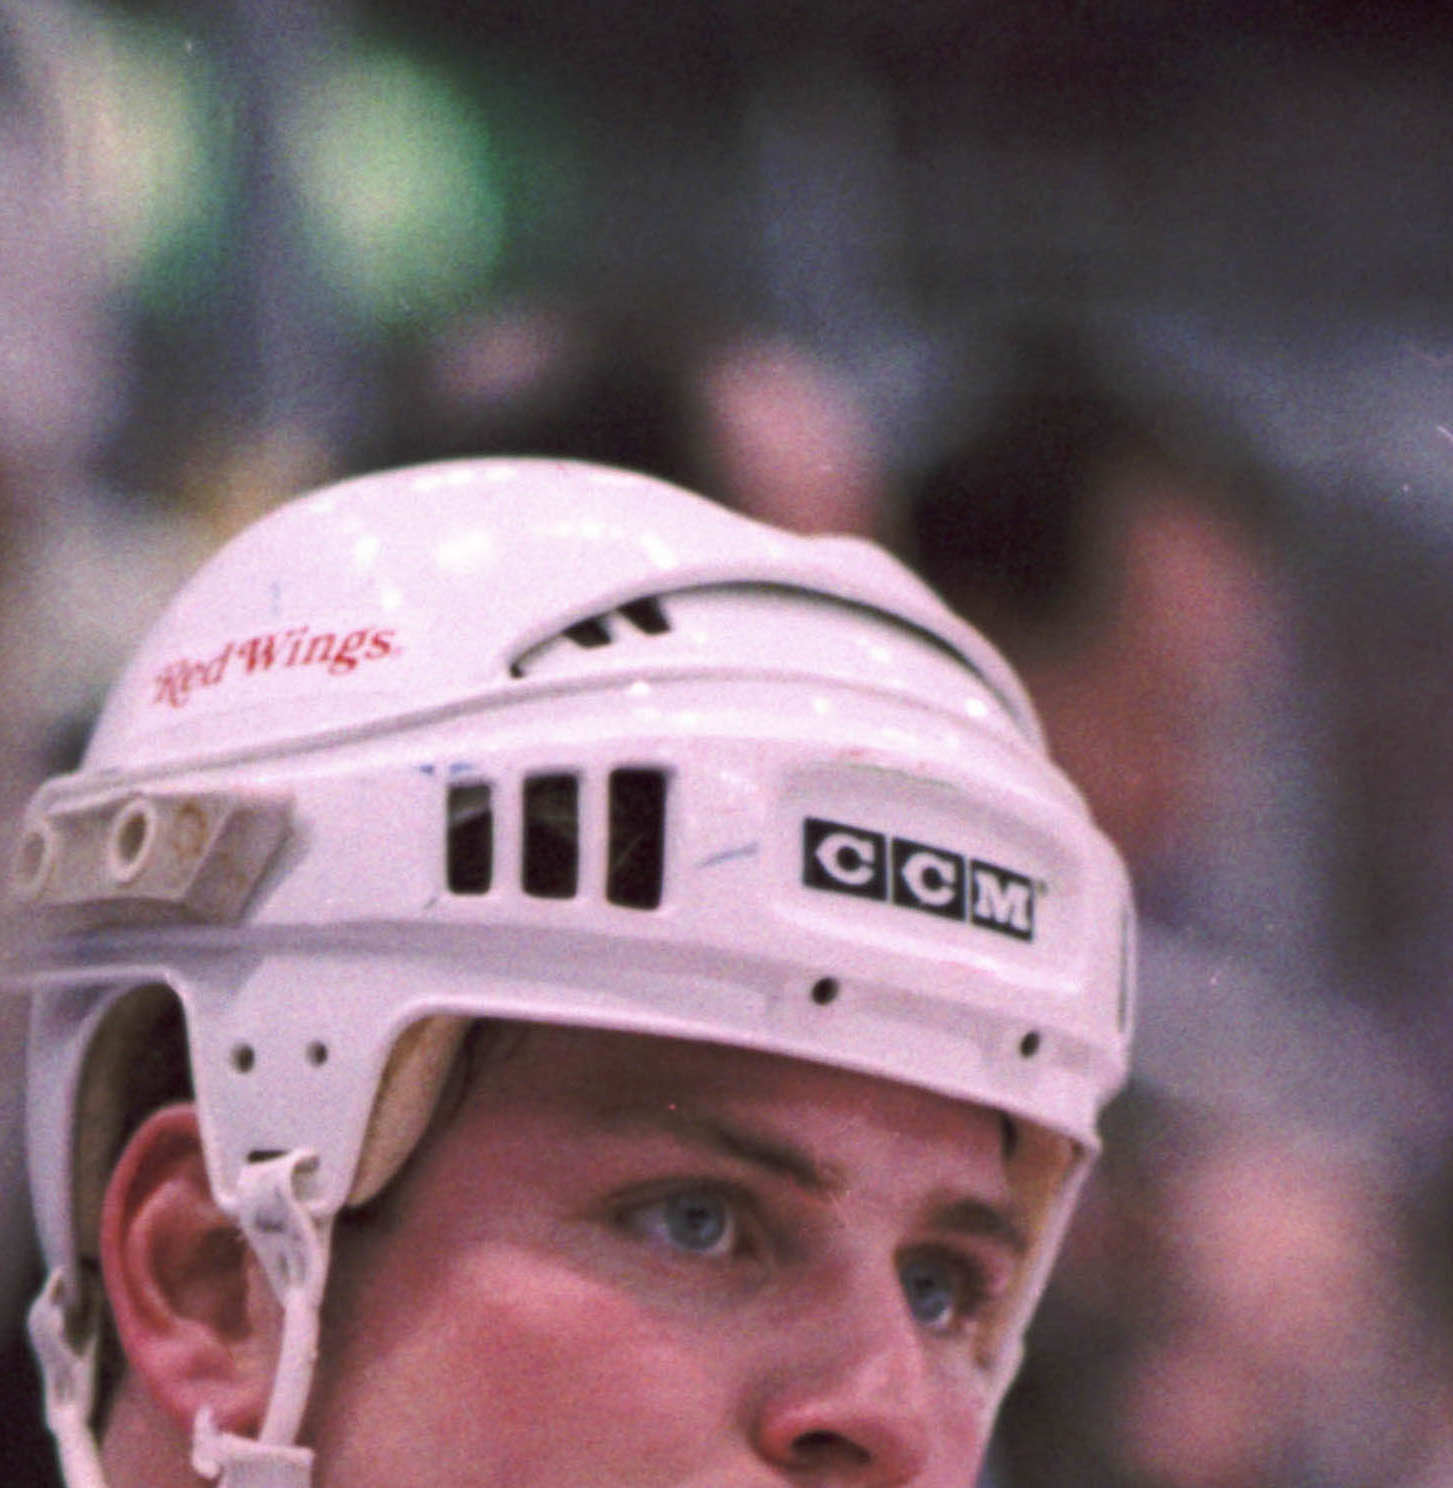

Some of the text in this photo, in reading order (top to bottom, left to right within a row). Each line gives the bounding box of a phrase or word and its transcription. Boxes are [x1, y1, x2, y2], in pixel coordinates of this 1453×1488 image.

[153, 625, 396, 709] Red Wings
[811, 830, 1033, 934] CCM
